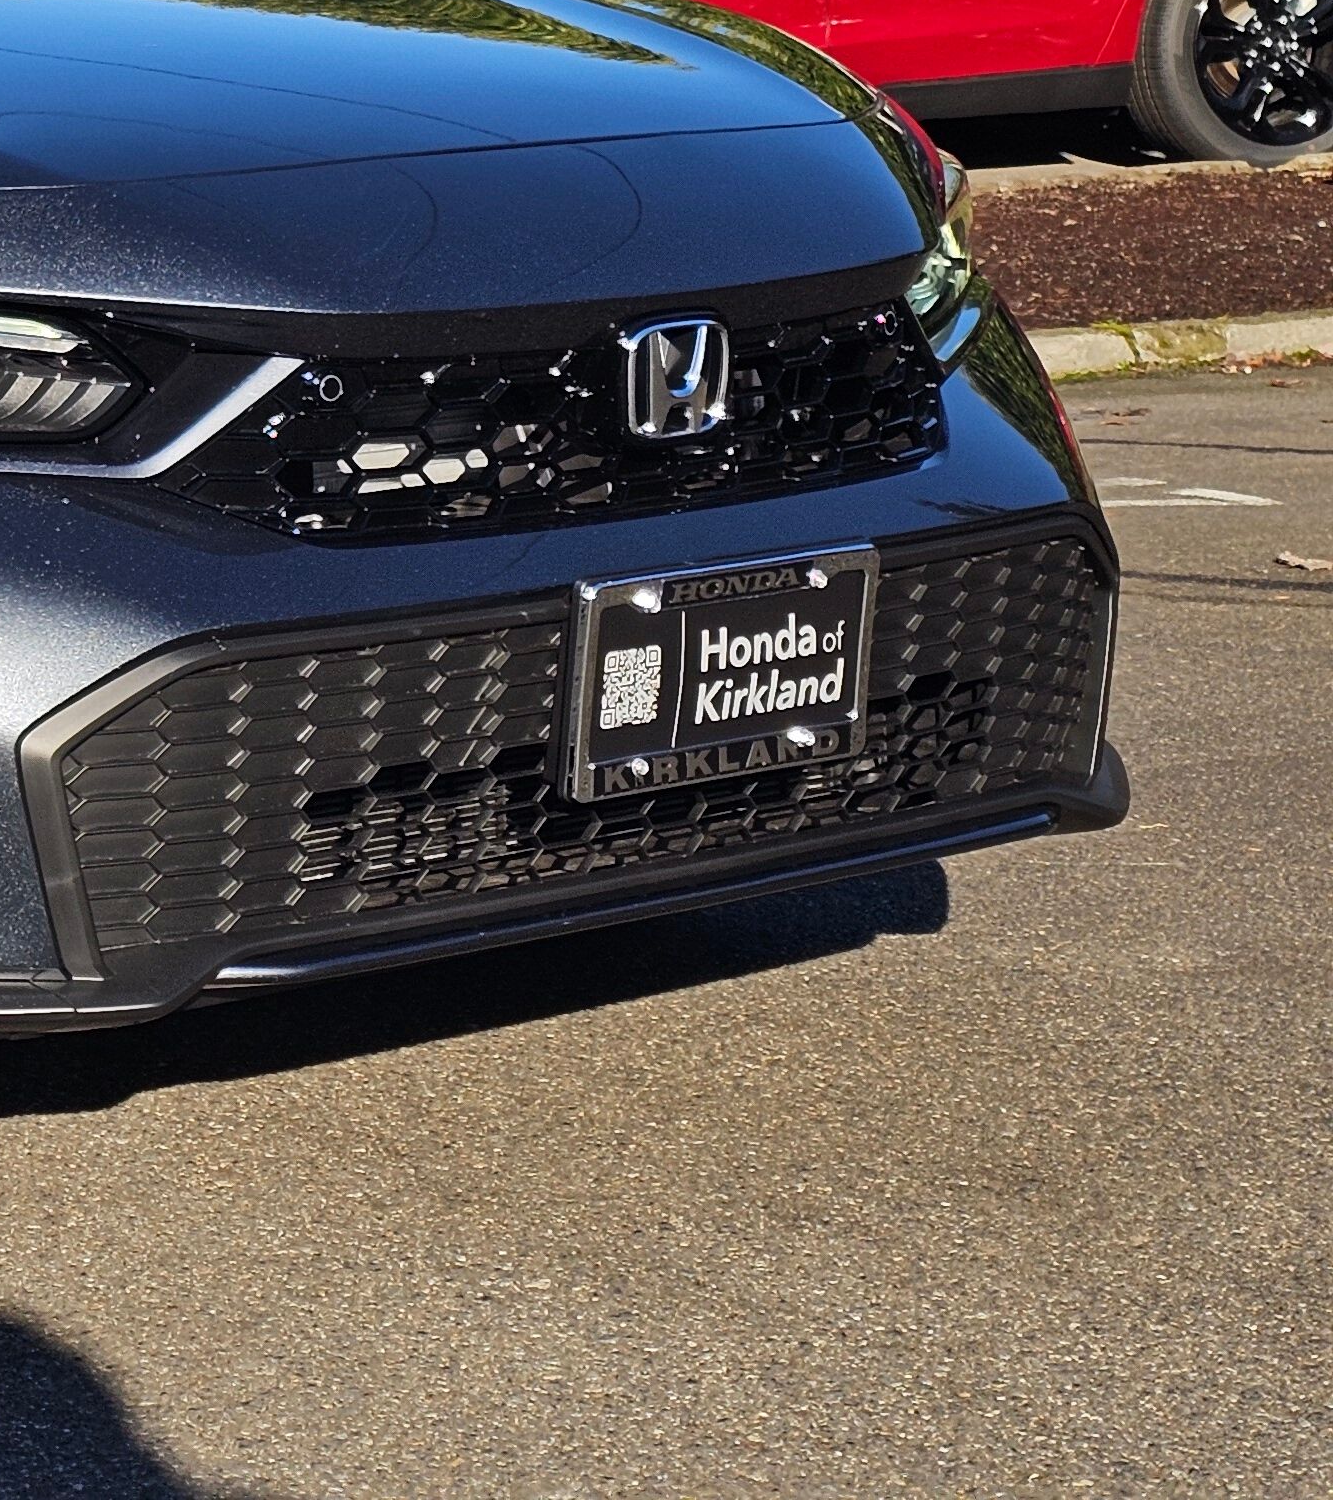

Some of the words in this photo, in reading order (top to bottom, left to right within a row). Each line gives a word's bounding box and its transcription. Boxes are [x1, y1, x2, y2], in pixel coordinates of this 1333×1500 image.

[669, 568, 800, 604] HONDA
[700, 612, 817, 672] Honda
[822, 620, 845, 652] of
[694, 657, 845, 724] Kirkland
